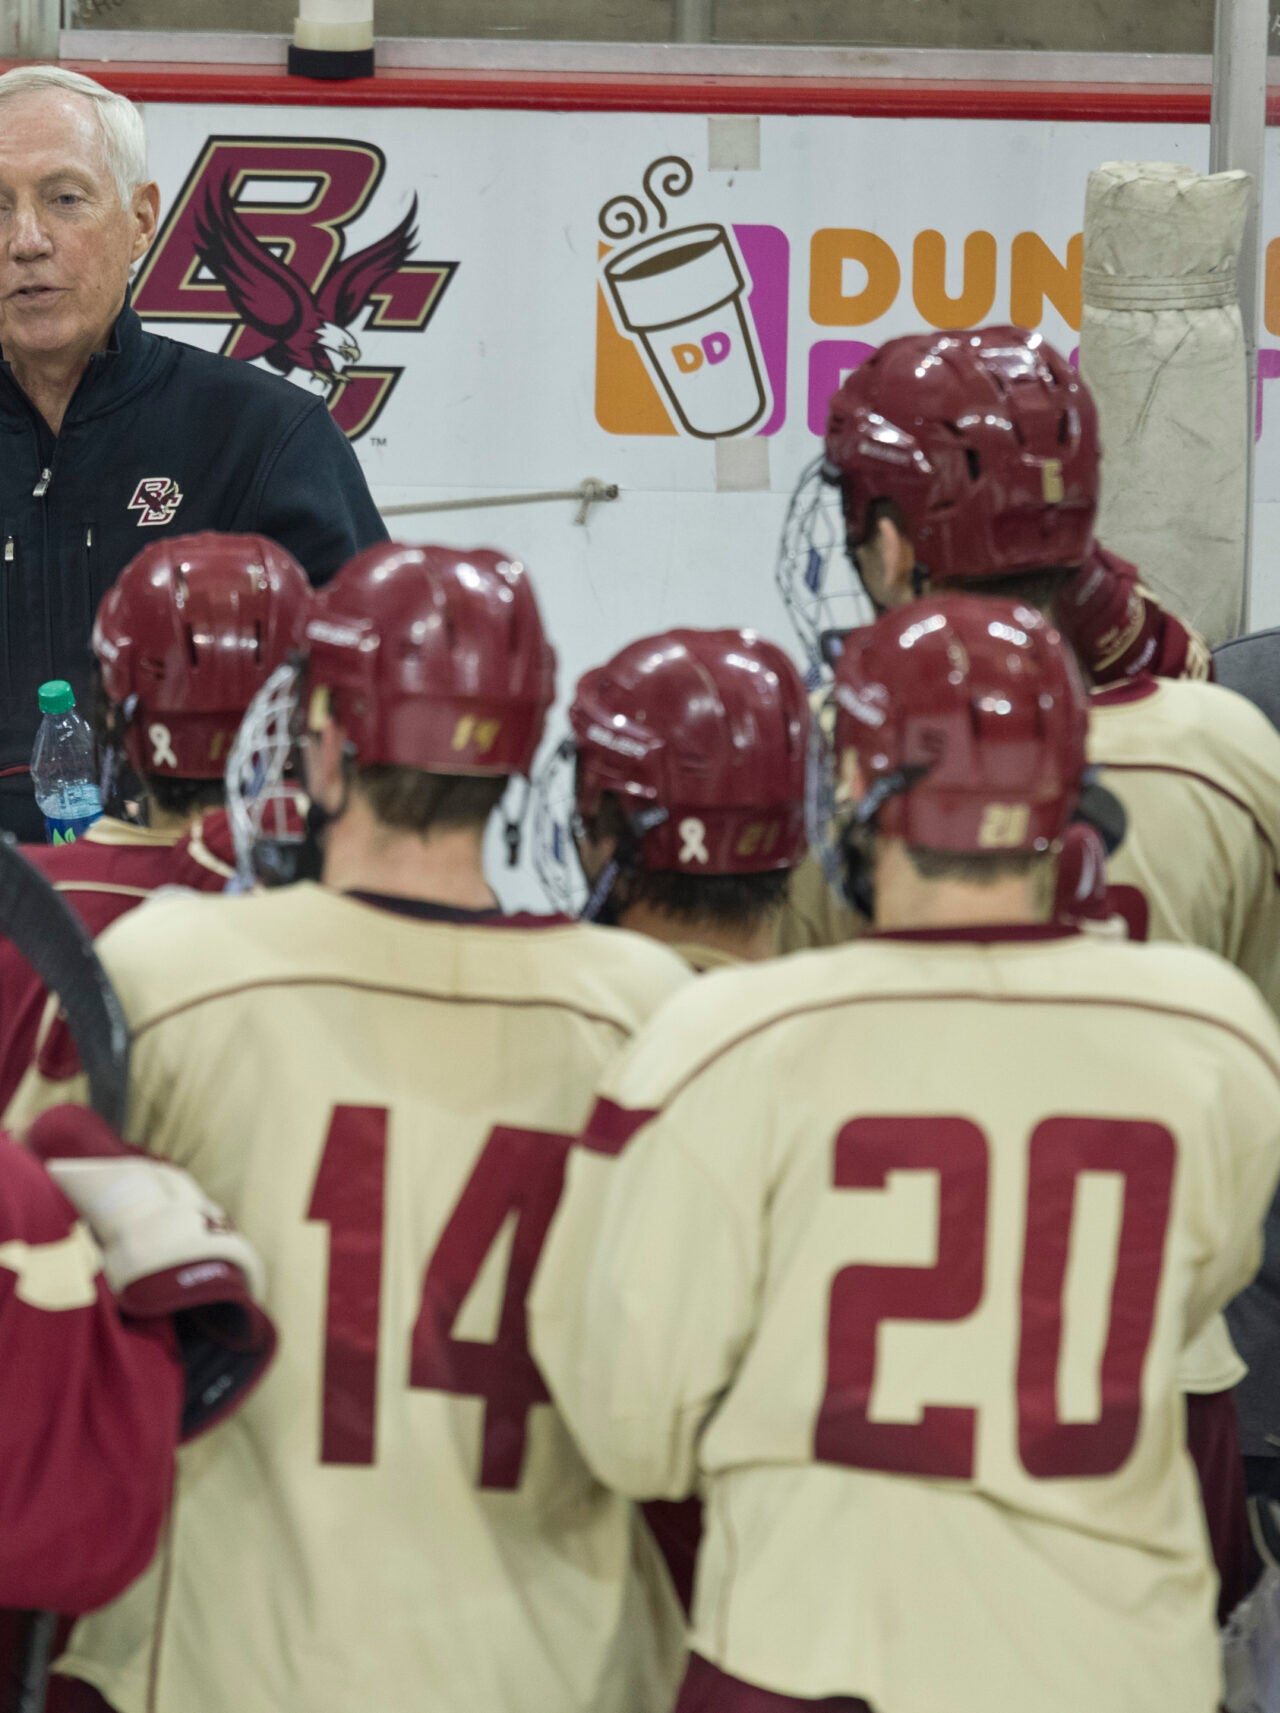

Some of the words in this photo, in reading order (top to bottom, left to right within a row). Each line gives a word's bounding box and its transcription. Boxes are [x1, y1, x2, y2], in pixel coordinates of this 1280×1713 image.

[809, 228, 1083, 331] DUN
[671, 332, 731, 373] DD
[369, 437, 388, 448] TM
[305, 1103, 583, 1491] 14
[813, 1113, 1179, 1481] 20
